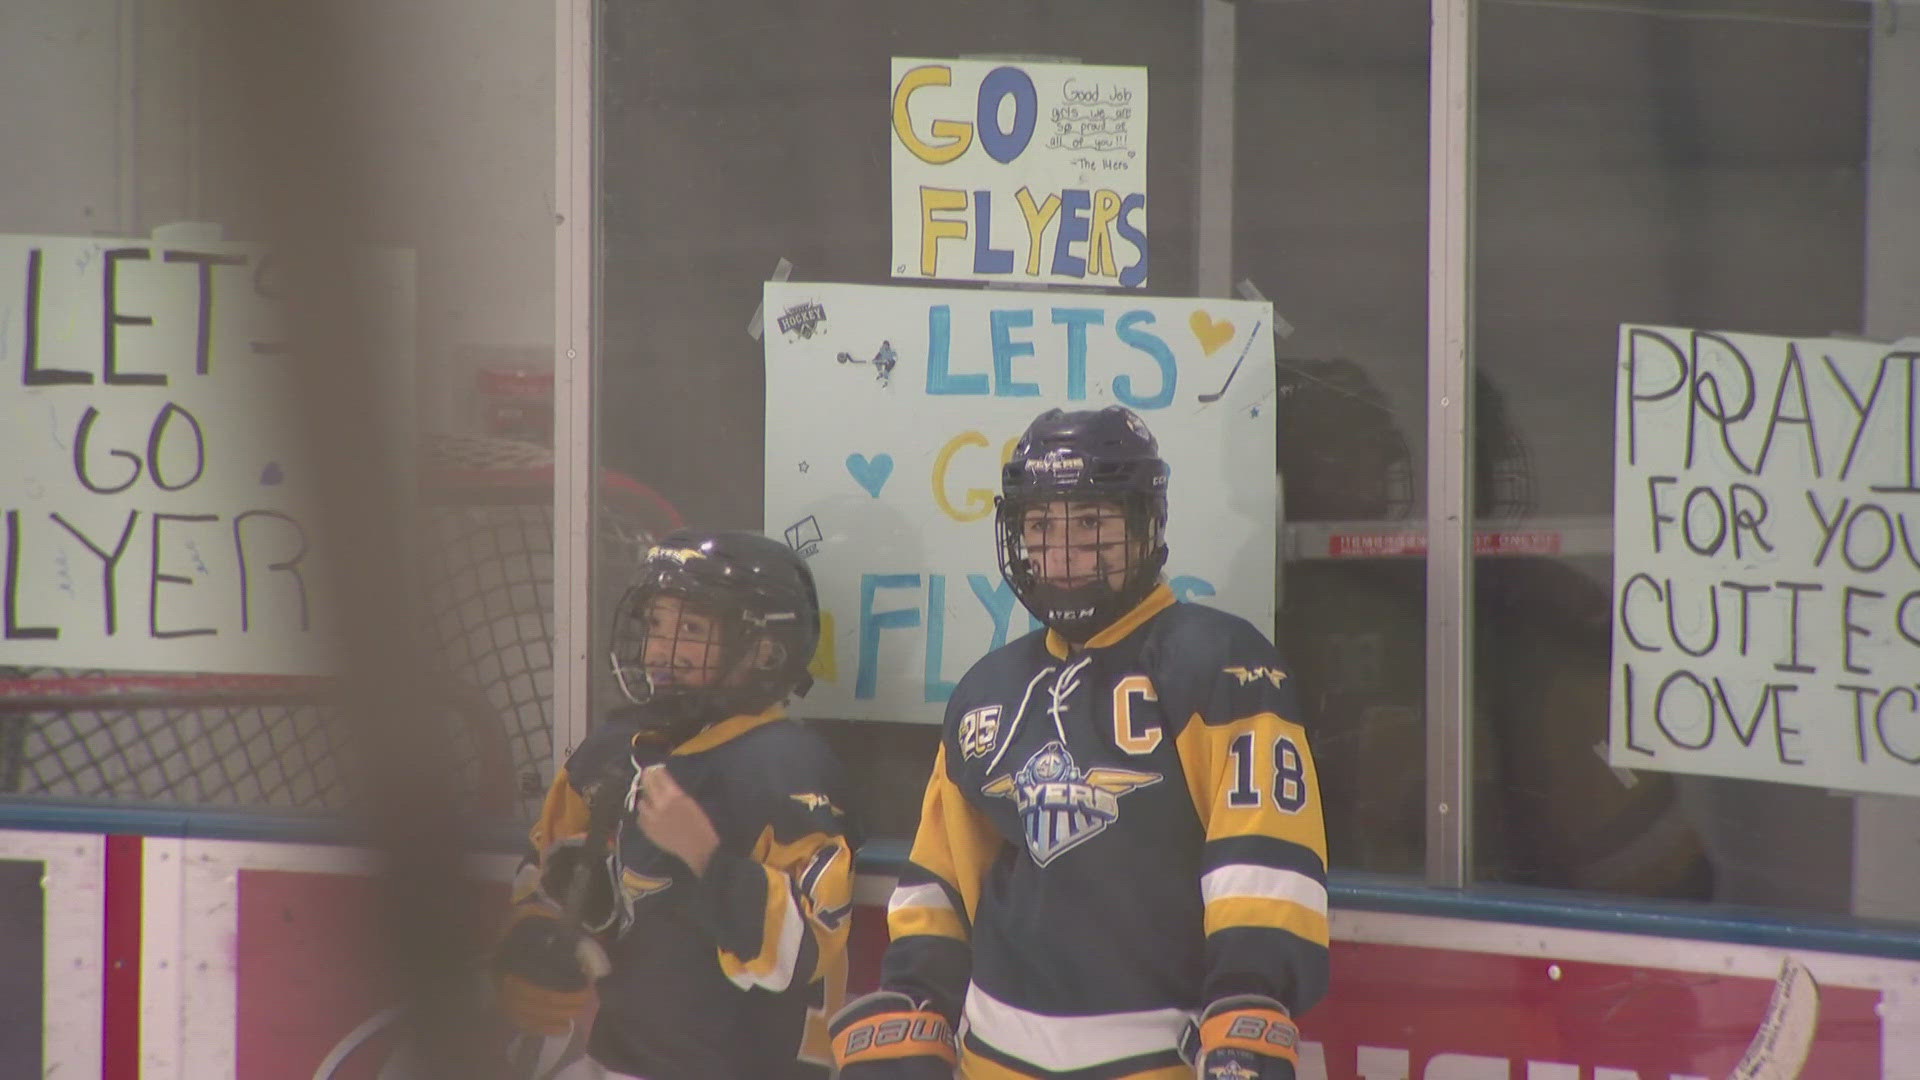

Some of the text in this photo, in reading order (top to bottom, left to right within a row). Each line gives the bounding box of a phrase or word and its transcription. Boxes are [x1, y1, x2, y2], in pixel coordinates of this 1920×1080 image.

[892, 64, 1038, 165] GO
[1063, 78, 1132, 102] Good Job
[1081, 119, 1106, 135] proud
[1090, 109, 1105, 119] we
[1050, 135, 1062, 147] all
[1072, 136, 1084, 148] of
[919, 185, 1148, 288] FLYERS
[781, 306, 824, 331] HOCKEY
[925, 303, 1178, 410] LETS
[73, 401, 205, 495] GO
[1648, 476, 1774, 560] FOR
[963, 707, 999, 753] 25
[1113, 675, 1164, 756] C
[1624, 663, 1805, 766] LOVE
[1228, 729, 1307, 816] 18
